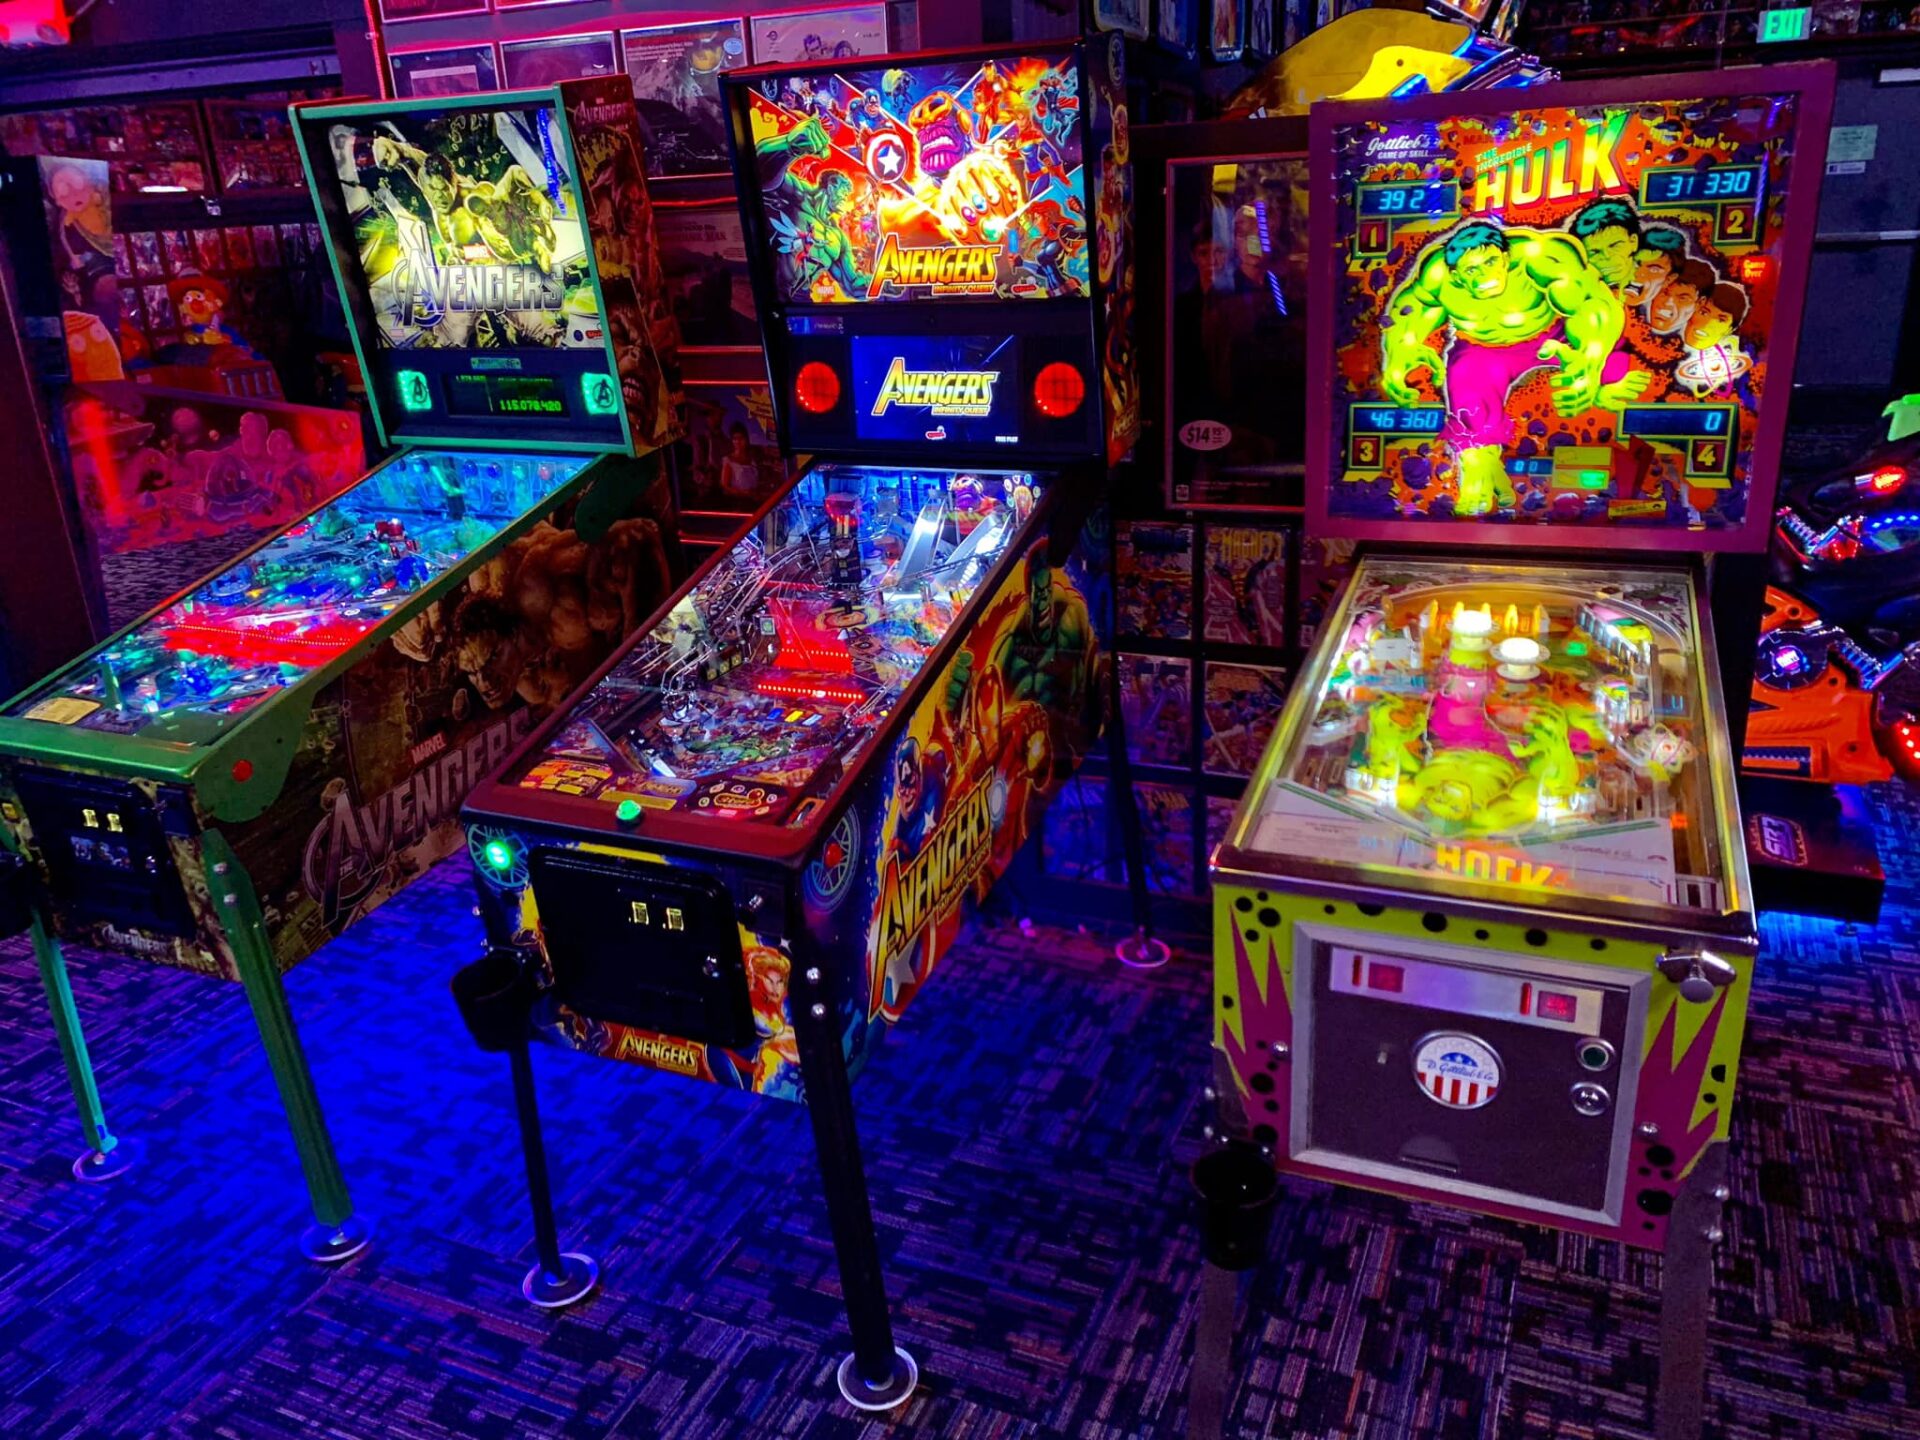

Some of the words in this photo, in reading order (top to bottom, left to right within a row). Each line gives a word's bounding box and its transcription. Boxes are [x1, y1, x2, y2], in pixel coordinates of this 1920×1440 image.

[1765, 8, 1807, 41] EXIT
[1399, 149, 1408, 158] OF
[1474, 112, 1631, 214] HULK
[1475, 147, 1498, 163] THE
[1703, 170, 1752, 195] 330
[1726, 209, 1745, 235] 2
[867, 232, 1003, 298] AVENGERS
[392, 248, 565, 328] AVENGERS
[871, 357, 1000, 416] AVENGERS
[1370, 410, 1395, 430] 46
[1399, 409, 1439, 429] 360
[1704, 412, 1722, 432] 0
[1359, 441, 1374, 463] 3
[1696, 444, 1716, 466] 4
[411, 732, 446, 765] MARVEL
[303, 706, 532, 930] AVENGERS
[868, 766, 994, 1024] AVENGERS
[615, 1026, 700, 1068] AVENGERS
